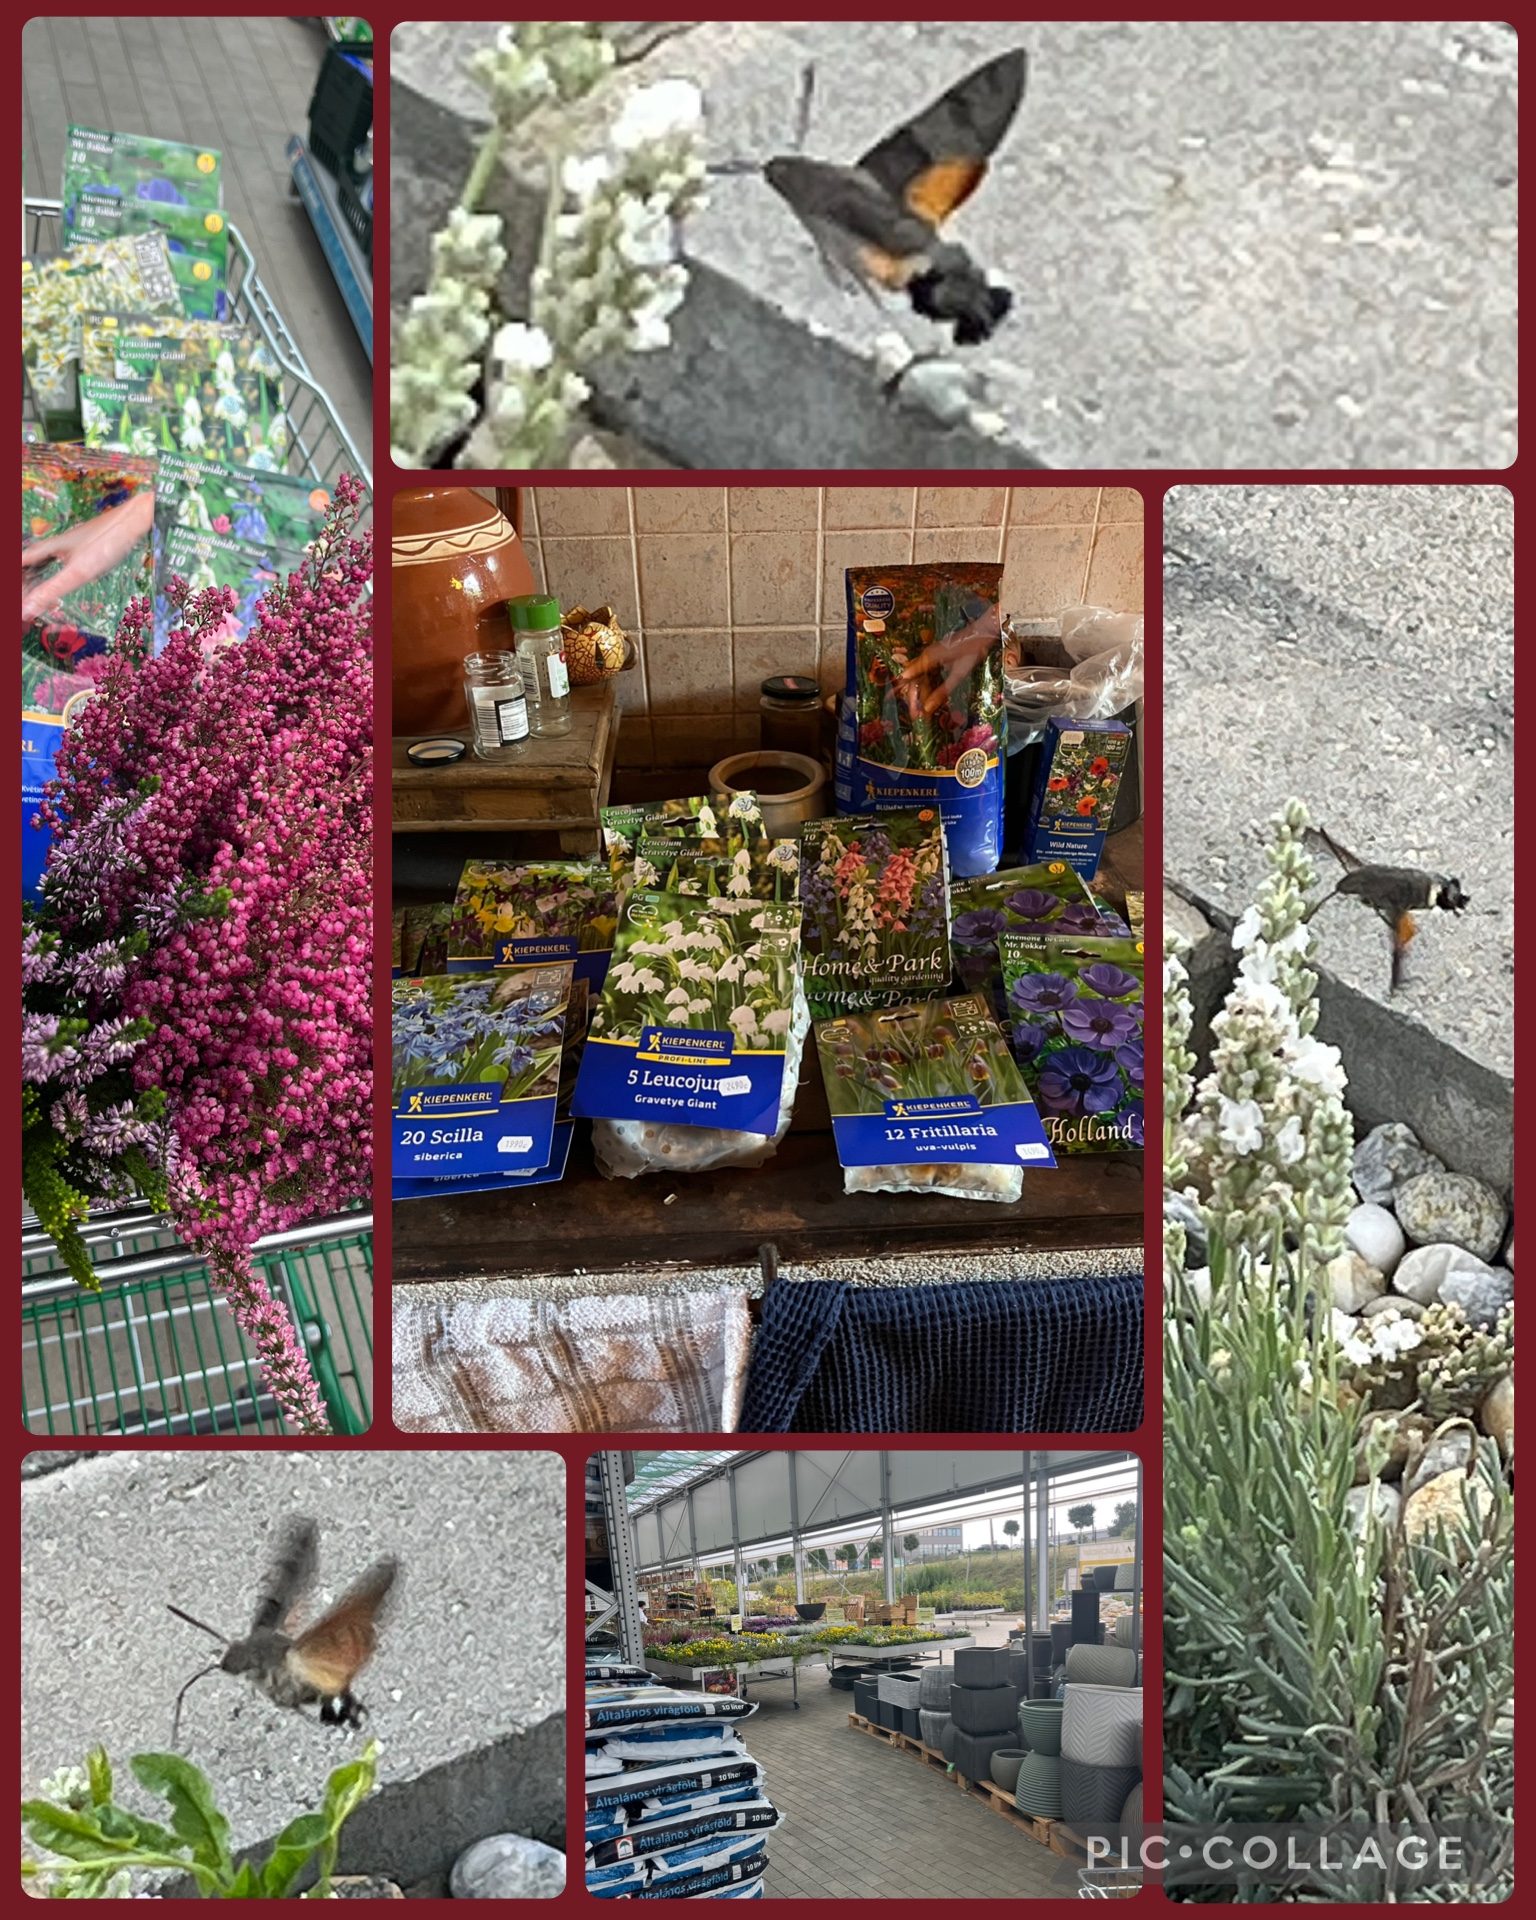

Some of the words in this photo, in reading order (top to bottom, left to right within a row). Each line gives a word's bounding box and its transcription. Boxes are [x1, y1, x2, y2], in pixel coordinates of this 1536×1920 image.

[157, 481, 176, 495] 10
[169, 553, 186, 567] 10
[876, 786, 940, 797] KIEPENKERL
[605, 806, 645, 818] Leucojum
[606, 814, 644, 827] Gravetye
[644, 813, 669, 822] Giant
[642, 838, 682, 848] Leucojum
[804, 833, 816, 842] 10
[1049, 841, 1065, 849] Wild
[1066, 842, 1088, 850] Nature
[640, 849, 679, 858] Gravetye
[680, 848, 704, 857] Giant
[631, 893, 644, 901] PG
[1004, 933, 1041, 942] Anemone
[514, 944, 571, 954] KIEPENKERL
[1004, 941, 1019, 949] Mr.
[1020, 942, 1047, 950] Fokker
[1007, 949, 1021, 959] 10
[801, 953, 863, 978] Home
[864, 958, 885, 974] &
[886, 946, 943, 973] Park
[869, 974, 900, 986] quality
[901, 971, 944, 984] gardening
[662, 1036, 726, 1050] KIEPENKERL
[658, 1054, 708, 1065] PROFI-LINE
[627, 1069, 639, 1085] 5
[423, 1091, 493, 1104] KIEPENKERL
[634, 1094, 684, 1108] Gravetye
[687, 1098, 718, 1110] Giant
[906, 1101, 971, 1112] KIEPENKERL
[400, 1130, 426, 1145] 20
[430, 1127, 484, 1145] Scilla
[884, 1128, 905, 1141] 12
[908, 1123, 998, 1140] Fritillaria
[1047, 1114, 1135, 1145] Holland
[915, 1142, 976, 1151] uva-vulpis
[413, 1151, 463, 1162] siberica
[597, 1707, 652, 1723] Általános
[653, 1704, 700, 1718] virágföld
[595, 1790, 650, 1810] Általános
[651, 1779, 698, 1798] virágföld
[718, 1774, 728, 1782] 10
[728, 1772, 741, 1781] liter
[639, 1829, 690, 1850] Általános
[691, 1816, 733, 1835] virágföld
[752, 1814, 760, 1822] 10
[760, 1813, 773, 1821] liter
[686, 1871, 729, 1891] virágföld
[746, 1863, 754, 1872] 10
